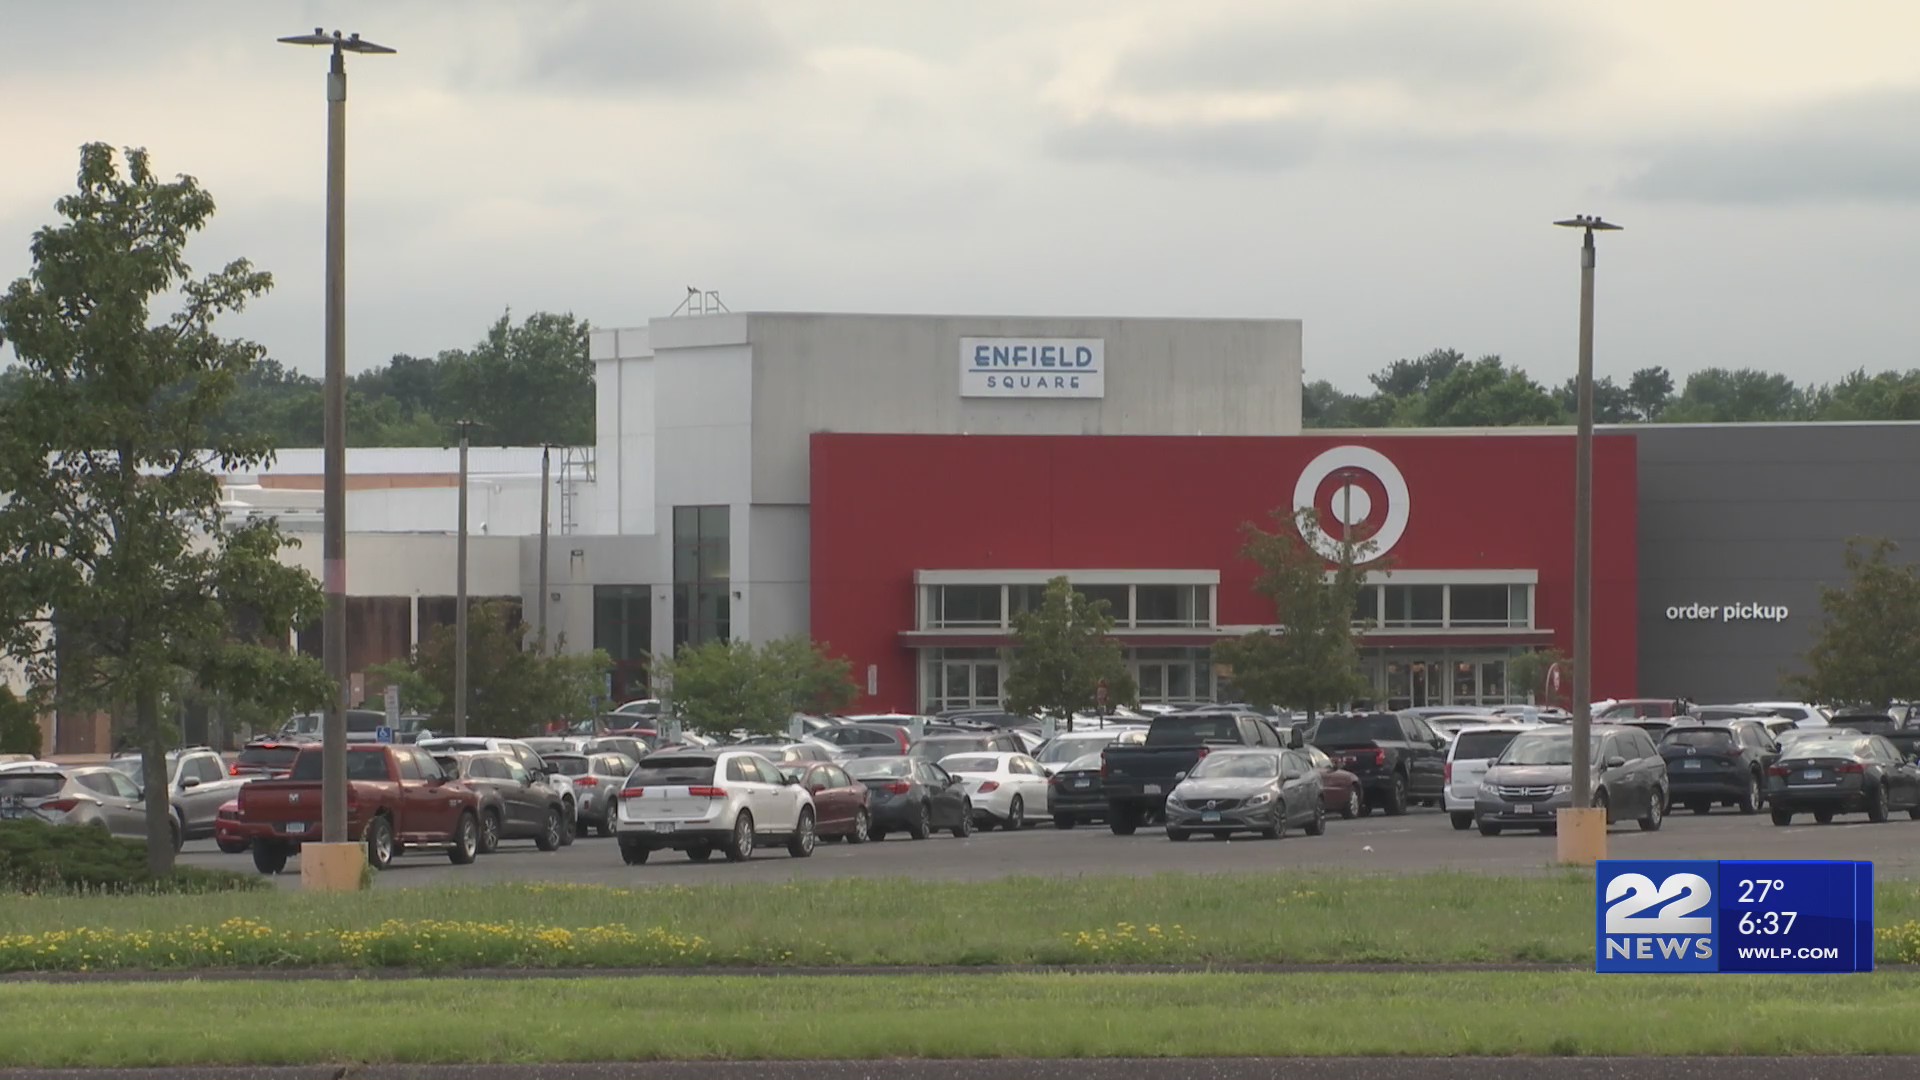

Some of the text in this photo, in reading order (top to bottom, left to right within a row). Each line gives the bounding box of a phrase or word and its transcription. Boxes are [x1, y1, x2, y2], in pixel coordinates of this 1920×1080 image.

[974, 345, 1093, 367] ENFIELD
[987, 376, 1080, 389] SQUARE
[1666, 602, 1789, 623] order pickup
